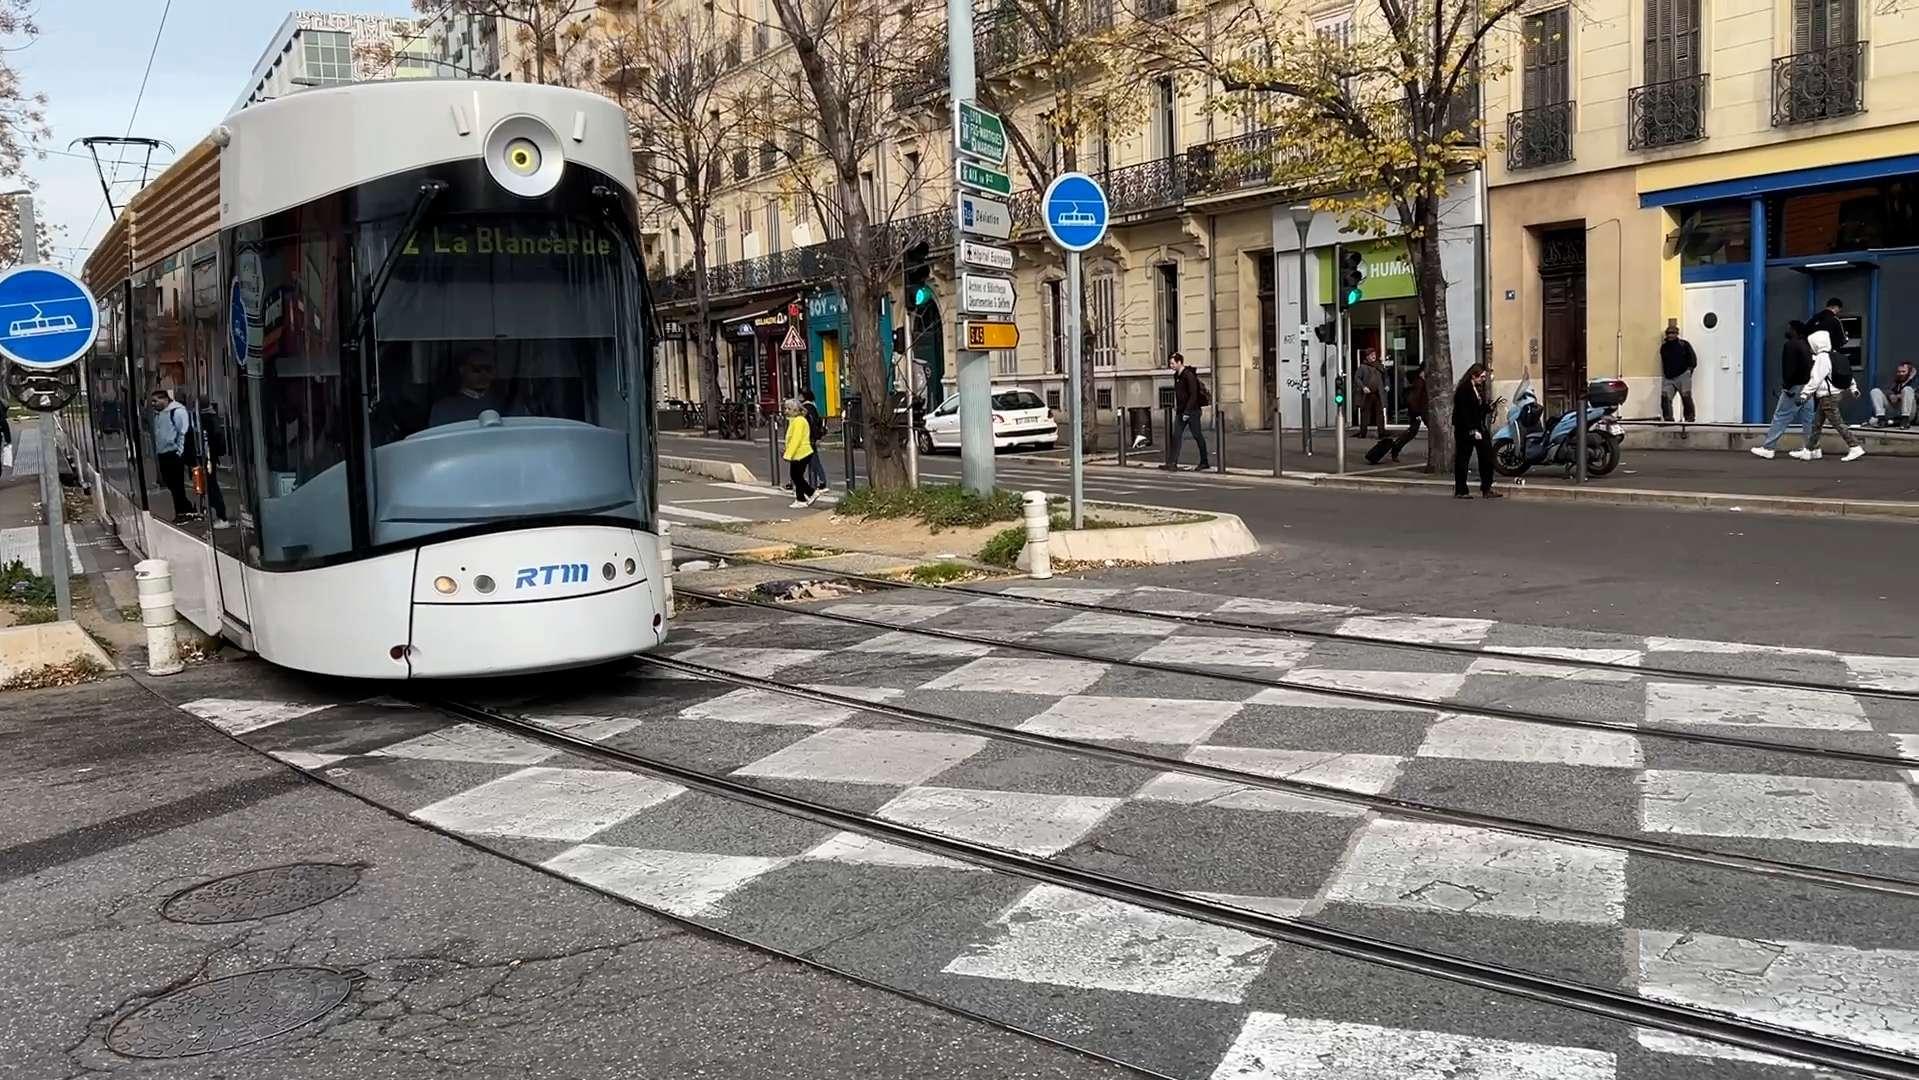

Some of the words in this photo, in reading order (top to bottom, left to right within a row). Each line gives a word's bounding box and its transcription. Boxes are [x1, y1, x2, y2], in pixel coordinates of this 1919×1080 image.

[969, 168, 978, 182] AIX
[976, 209, 999, 225] Déviation
[433, 226, 468, 254] La
[477, 227, 611, 255] Blancarde
[973, 247, 990, 262] Hôpital
[991, 251, 1011, 266] Européen
[515, 563, 589, 589] RTM
